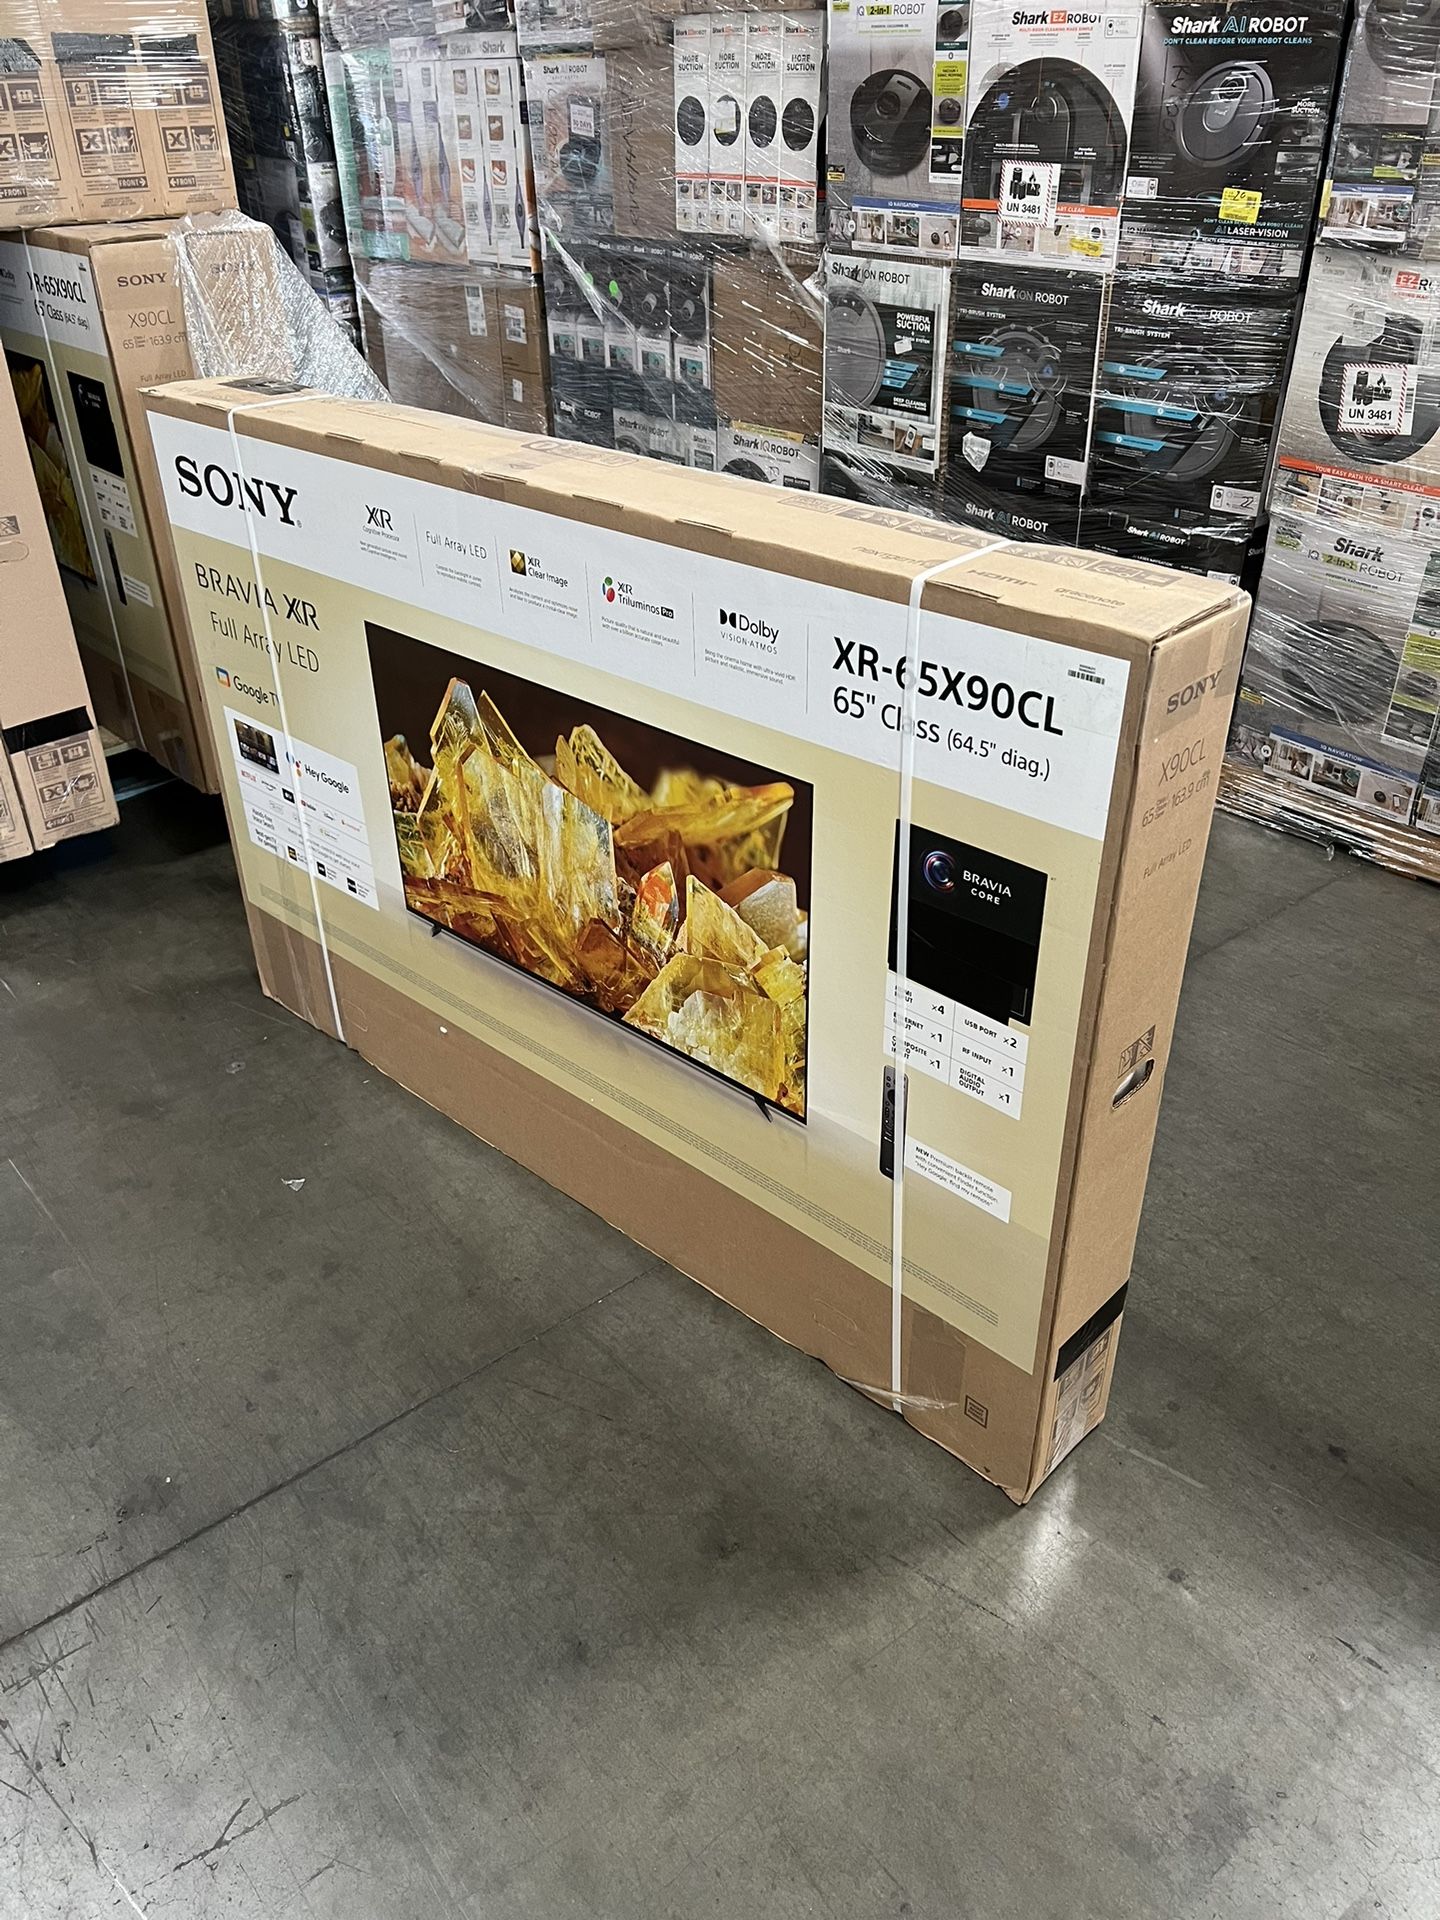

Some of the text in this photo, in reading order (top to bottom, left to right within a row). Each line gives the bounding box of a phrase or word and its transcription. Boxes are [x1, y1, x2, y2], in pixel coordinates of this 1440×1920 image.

[868, 5, 890, 15] 2-in-1
[893, 3, 926, 15] ROBOT
[1011, 11, 1102, 25] Shark EZ ROBOT
[1171, 16, 1309, 35] Shark AI ROBOT
[481, 40, 506, 54] Shark
[682, 55, 699, 63] MORE
[714, 61, 740, 70] SUCTION
[719, 53, 735, 61] MORE
[750, 61, 776, 70] SUCTION
[755, 53, 771, 61] MORE
[791, 54, 811, 63] MORE
[543, 64, 588, 74] Shark ROBOT
[786, 63, 816, 71] SUCTION
[1290, 106, 1321, 115] SUCTION
[119, 178, 140, 187] FRONT
[175, 176, 196, 187] FRONT
[1006, 202, 1041, 215] UN 3481
[117, 272, 168, 288] SONY
[831, 261, 863, 283] Shark
[878, 269, 911, 285] ROBOT
[981, 282, 1016, 300] Shark
[1035, 291, 1070, 306] ROBOT
[128, 309, 176, 329] X90CL
[896, 312, 931, 324] POWERFUL
[986, 311, 1006, 319] SYSTEM
[1142, 299, 1253, 324] Shark ROBOT
[896, 319, 931, 333] SUCTION
[1146, 329, 1172, 339] SYSTEM
[122, 337, 134, 350] 65
[1348, 408, 1365, 420] UN
[733, 433, 760, 450] Shark
[770, 444, 801, 459] ROBOT
[1315, 465, 1332, 474] YOUR
[1332, 468, 1348, 478] EASY
[1347, 472, 1364, 481] PATH
[1364, 475, 1373, 483] TO
[1380, 478, 1402, 488] SMART
[1402, 482, 1425, 493] CLEAN
[174, 454, 299, 527] SONY
[364, 504, 394, 532] XR
[965, 503, 1049, 533] Shark ROBOT
[1126, 526, 1187, 545] Shark ROBOT
[425, 531, 487, 560] Full Array LED
[1334, 537, 1385, 562] Shark
[528, 556, 541, 568] XR
[1325, 554, 1354, 570] 2-in-1
[1359, 562, 1405, 582] ROBOT
[528, 567, 568, 588] Clear Image
[966, 567, 1028, 587] HDMI
[194, 562, 320, 631] BRAVIA XR
[617, 580, 634, 595] XR
[1053, 586, 1127, 608] gracenote
[617, 592, 673, 619] Triluminos Pro
[738, 613, 779, 645] Dolby
[210, 611, 239, 641] Full
[287, 640, 320, 673] LED
[232, 675, 270, 706] Google
[1166, 669, 1223, 716] SONY
[833, 686, 1052, 783] 65" Clss (64.5" diag.)
[1157, 738, 1207, 788] X90CL
[1327, 747, 1363, 762] NAVIGATION
[304, 763, 350, 795] Hey Google
[1142, 807, 1155, 827] 65
[1177, 838, 1193, 857] LED
[963, 869, 1012, 898] BRAVIA
[970, 887, 1001, 906] CORE
[964, 1018, 998, 1039] USB PORT
[962, 1046, 993, 1066] RF INPUT
[959, 1067, 986, 1086] DIGITAL
[959, 1074, 982, 1089] AUDIO
[958, 1080, 986, 1097] OUTPUT
[915, 1146, 994, 1193] NEW Premium backlit remote
[915, 1154, 976, 1190] with convenient Finder
[949, 1179, 961, 1190] find
[960, 1186, 971, 1196] my
